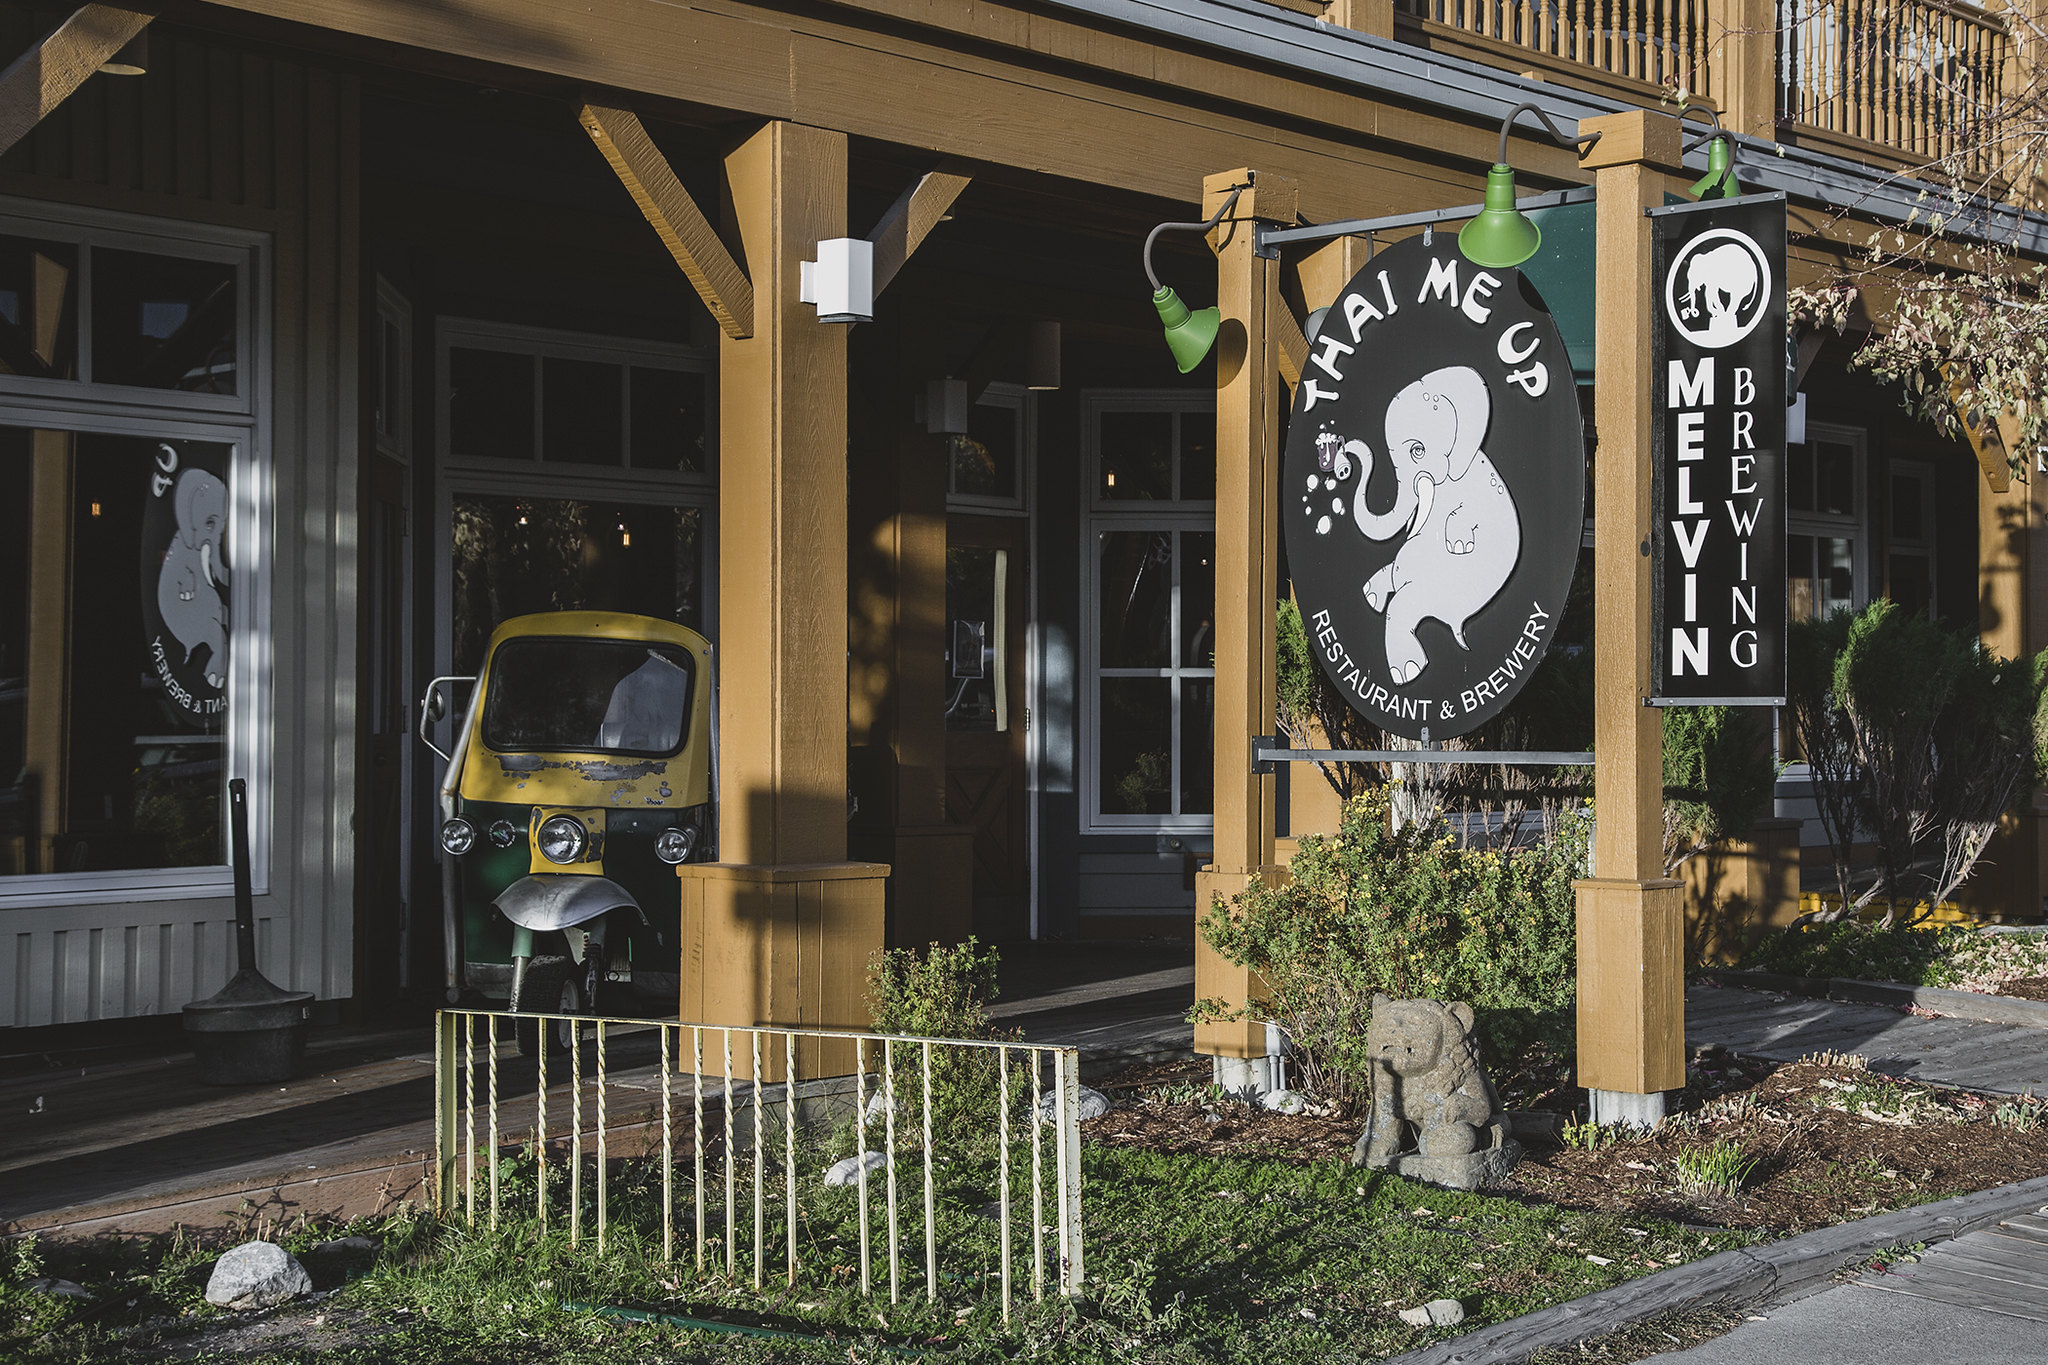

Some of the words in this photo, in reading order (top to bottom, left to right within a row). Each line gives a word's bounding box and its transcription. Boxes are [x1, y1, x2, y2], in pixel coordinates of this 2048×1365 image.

[1303, 269, 1399, 412] THAI
[1417, 256, 1503, 325] ME
[1496, 321, 1550, 398] UP
[1668, 357, 1716, 677] MELVIN
[1725, 367, 1764, 668] BREWING
[1311, 608, 1433, 721] RESTAURANT
[1439, 699, 1457, 720] &
[1459, 600, 1551, 713] BREWERY
